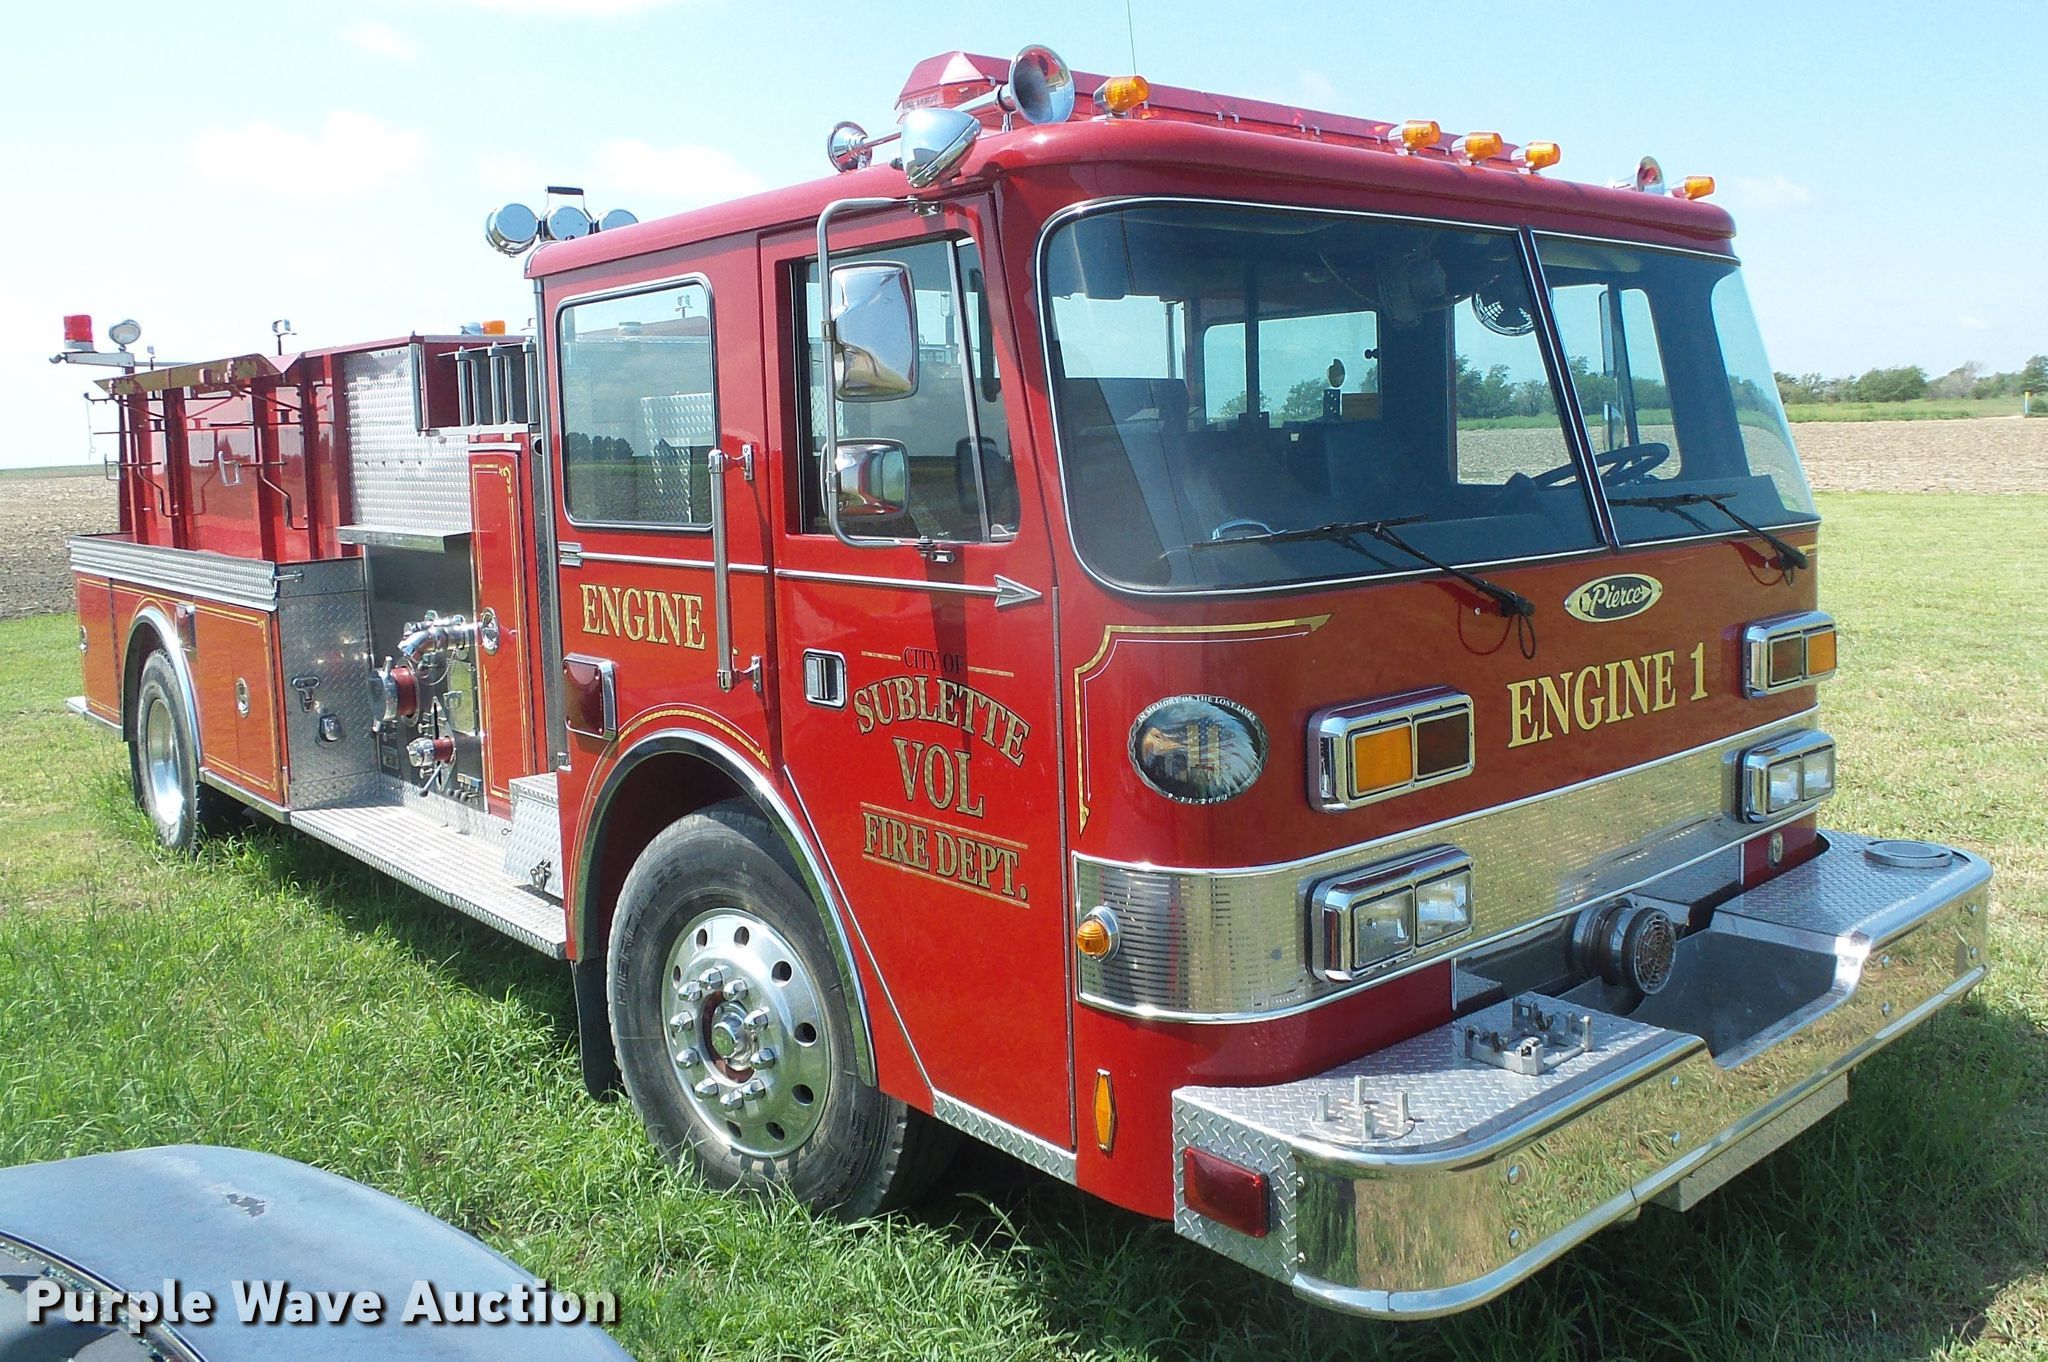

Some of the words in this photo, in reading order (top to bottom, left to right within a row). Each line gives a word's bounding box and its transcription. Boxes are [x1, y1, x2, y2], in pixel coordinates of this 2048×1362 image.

[579, 583, 706, 650] ENGINE
[1590, 583, 1643, 616] Pierce
[903, 647, 939, 670] CITY
[943, 653, 965, 675] OF
[1506, 650, 1677, 748] ENGINE
[1690, 641, 1708, 701] 1
[853, 675, 1031, 767] SUBLETTE
[1146, 696, 1180, 717] MEMORY
[1182, 695, 1196, 703] OF
[1195, 695, 1214, 703] THE
[1215, 696, 1237, 708] LOST
[1236, 704, 1257, 721] LIVES
[892, 736, 985, 818] VOL
[1168, 792, 1228, 805] 9-11-2001
[862, 811, 930, 871] FIRE
[935, 829, 1029, 901] DEPT.
